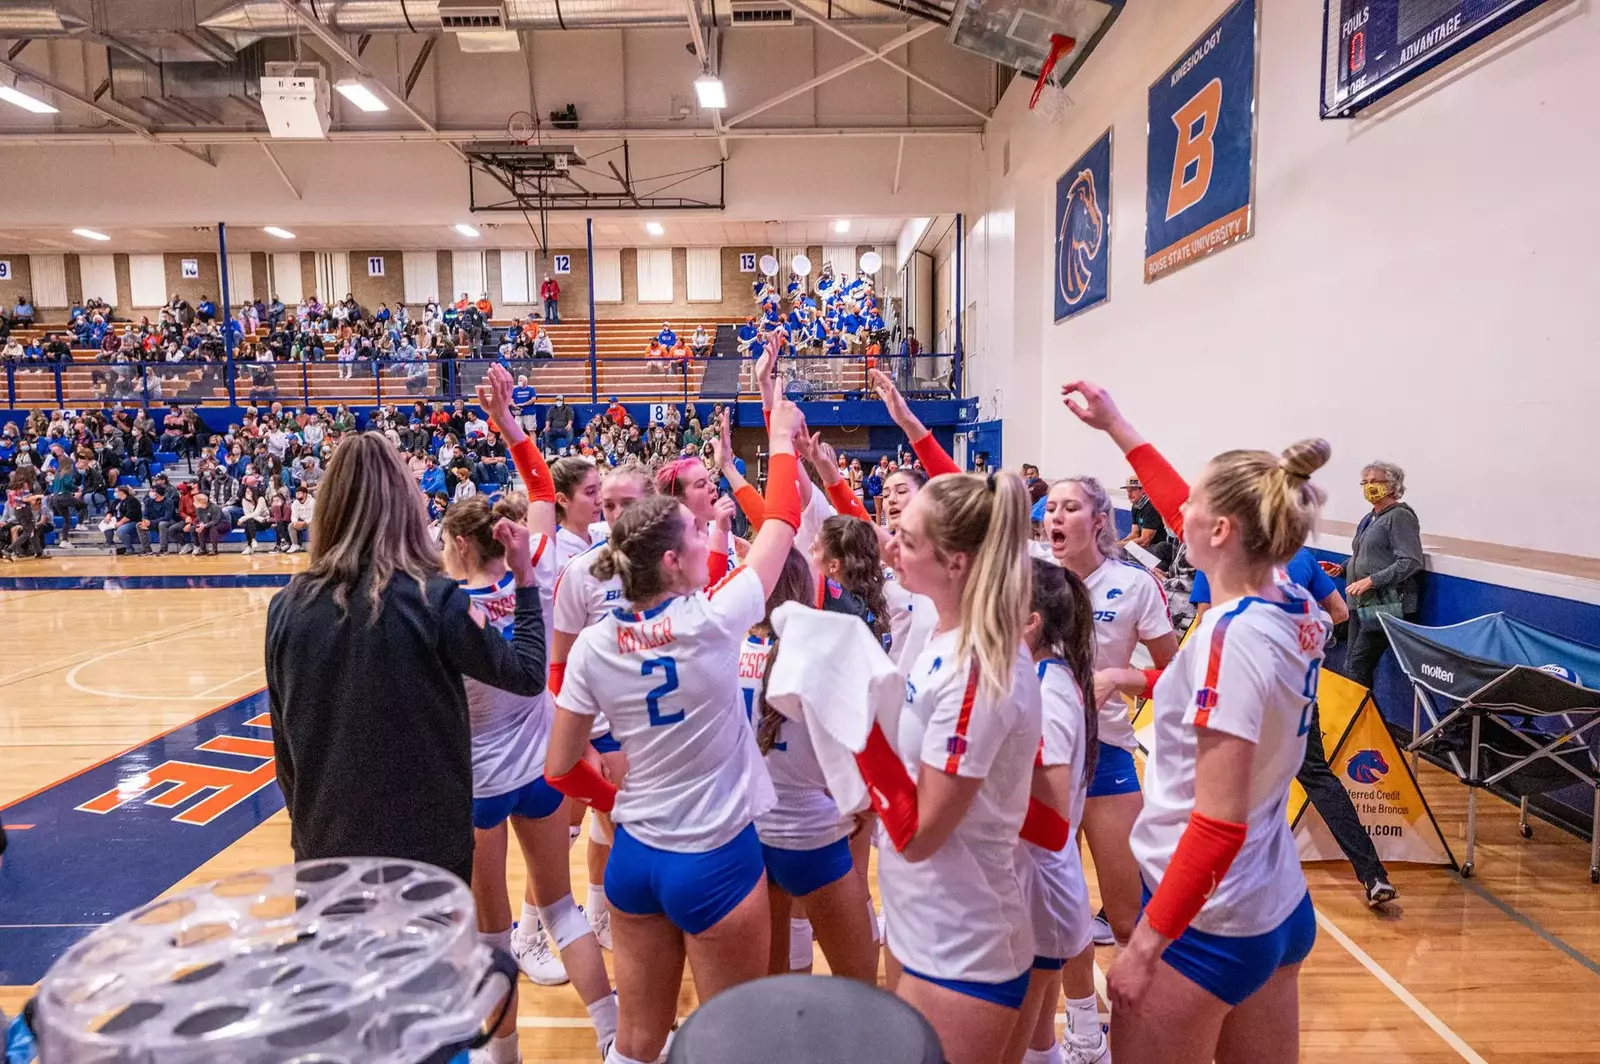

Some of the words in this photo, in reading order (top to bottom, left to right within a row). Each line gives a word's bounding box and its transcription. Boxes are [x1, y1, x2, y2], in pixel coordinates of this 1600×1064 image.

[1342, 6, 1369, 39] FOULS
[1400, 13, 1461, 66] ADVANTAGE
[1170, 27, 1222, 88] KINESIOLOGY
[1165, 77, 1222, 222] B
[1149, 256, 1168, 276] BOISE
[1168, 244, 1191, 266] STATE
[1191, 217, 1242, 254] UNIVERSITY
[370, 258, 382, 273] 11
[555, 256, 570, 271] 12
[741, 255, 755, 270] 13
[655, 405, 664, 421] 8
[616, 617, 677, 655] MILLER
[1421, 663, 1454, 684] molten
[641, 656, 685, 727] 2
[1377, 789, 1401, 801] Credit
[1363, 804, 1377, 813] the
[1378, 804, 1409, 814] Broncos
[1364, 825, 1402, 837] u.com
